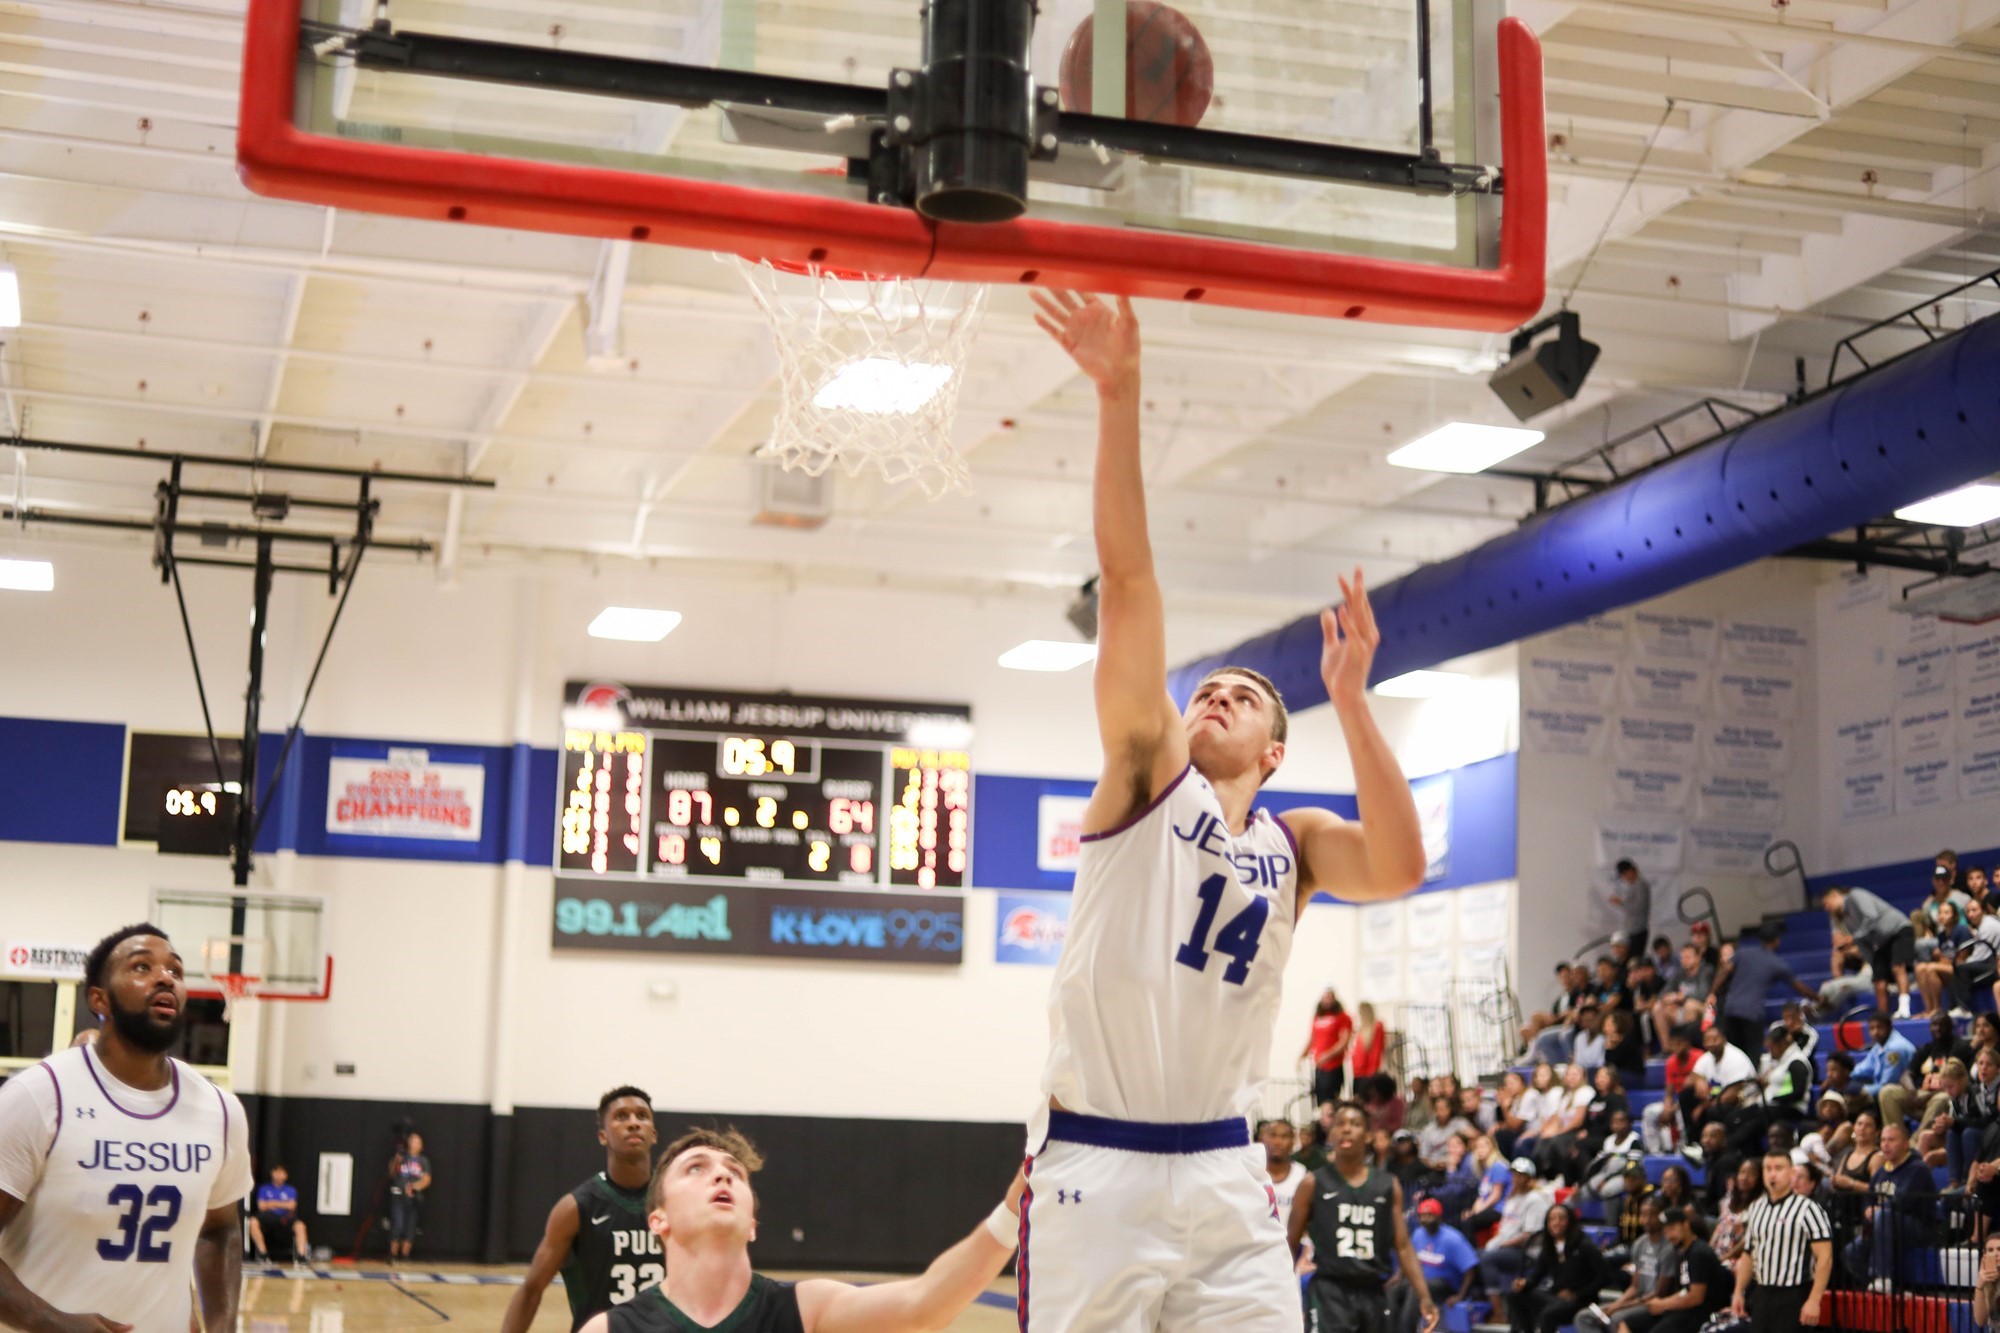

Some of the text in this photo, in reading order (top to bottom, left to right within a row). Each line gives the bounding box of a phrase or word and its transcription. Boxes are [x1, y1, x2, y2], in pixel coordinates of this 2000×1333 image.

[626, 697, 730, 723] WILLIAM
[733, 702, 824, 728] JESSUP
[723, 737, 796, 776] 05.9
[166, 789, 216, 816] 05.9
[336, 799, 472, 829] CHAMPIONS
[668, 789, 712, 826] 87
[829, 798, 873, 834] 64
[556, 898, 641, 936] 99.1
[1175, 872, 1269, 986] 14
[31, 948, 88, 967] RESTROO
[77, 1139, 211, 1173] JESSUP
[96, 1183, 182, 1263] 32
[1338, 1203, 1375, 1225] PUC
[611, 1229, 663, 1256] PUC
[1336, 1226, 1375, 1260] 25
[609, 1263, 665, 1305] 32
